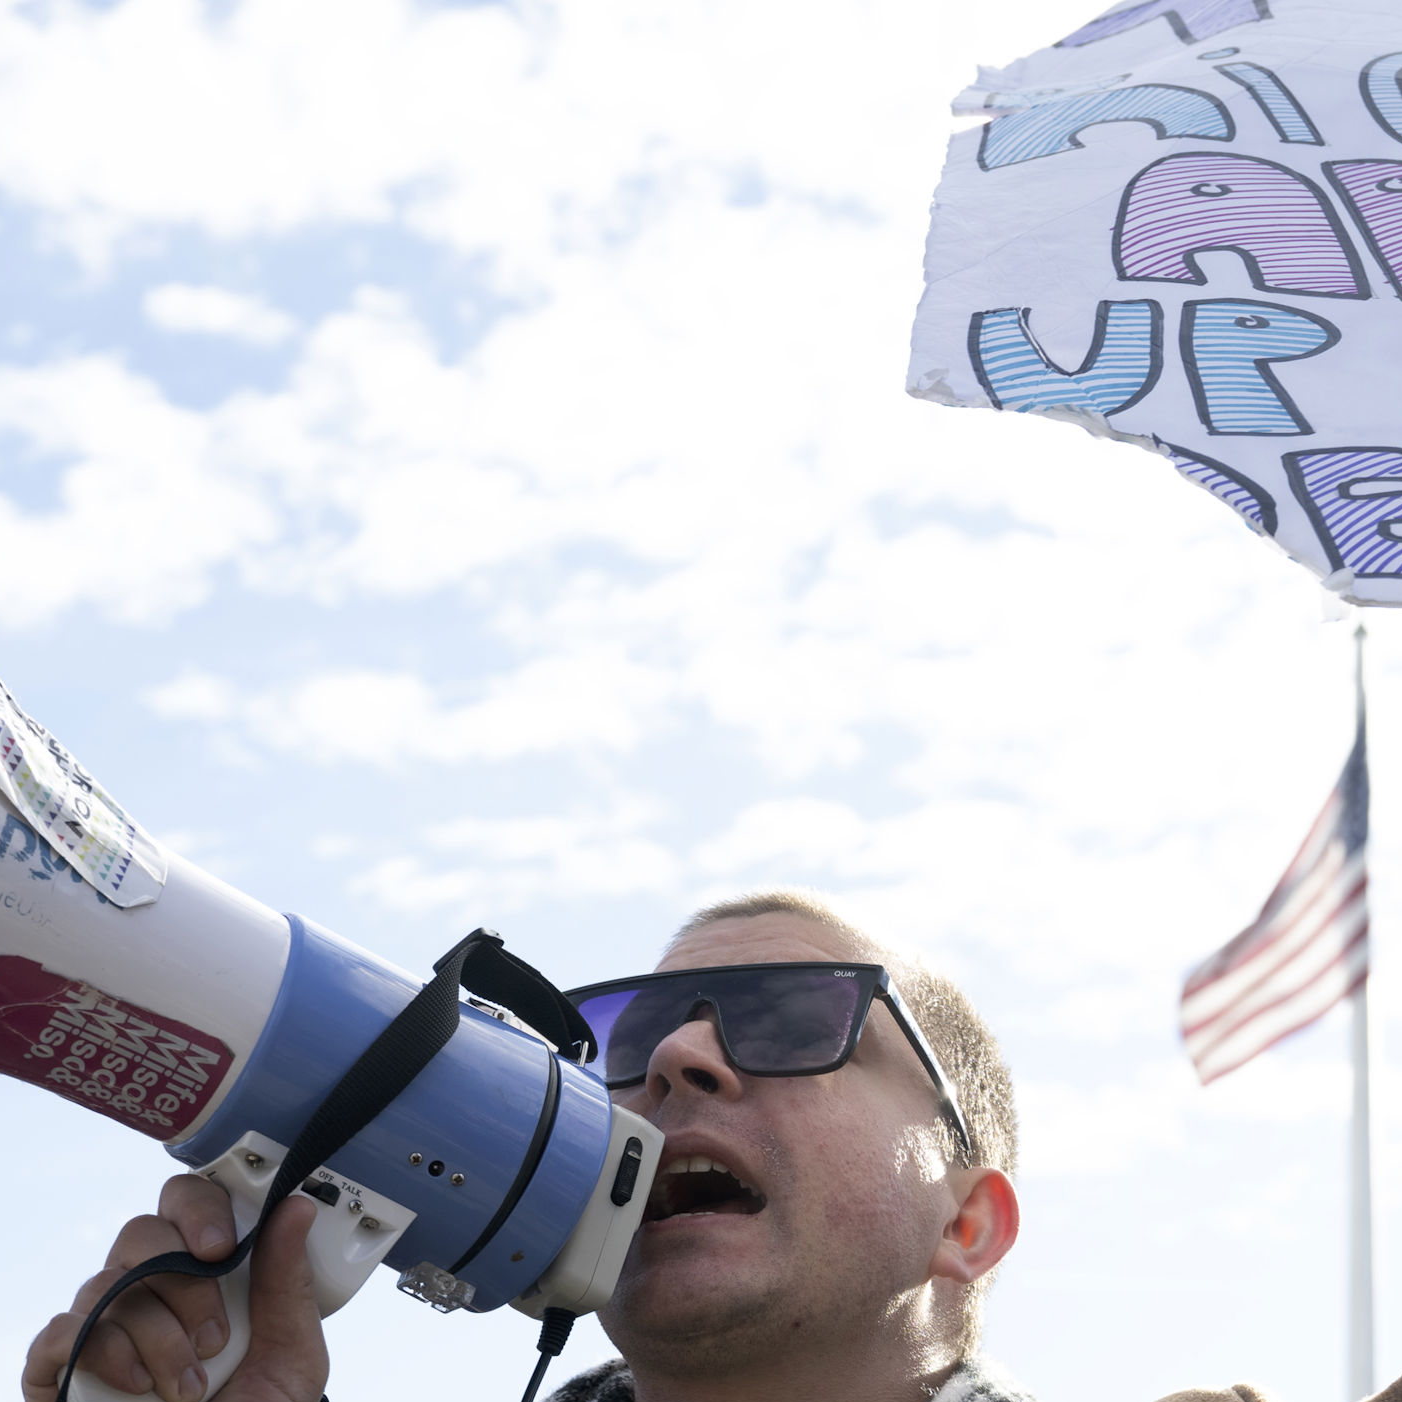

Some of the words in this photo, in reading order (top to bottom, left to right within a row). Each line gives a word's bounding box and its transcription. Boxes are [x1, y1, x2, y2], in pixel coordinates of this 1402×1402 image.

[968, 297, 1342, 436] UP
[319, 1171, 335, 1183] OFF
[341, 1182, 363, 1198] TALK
